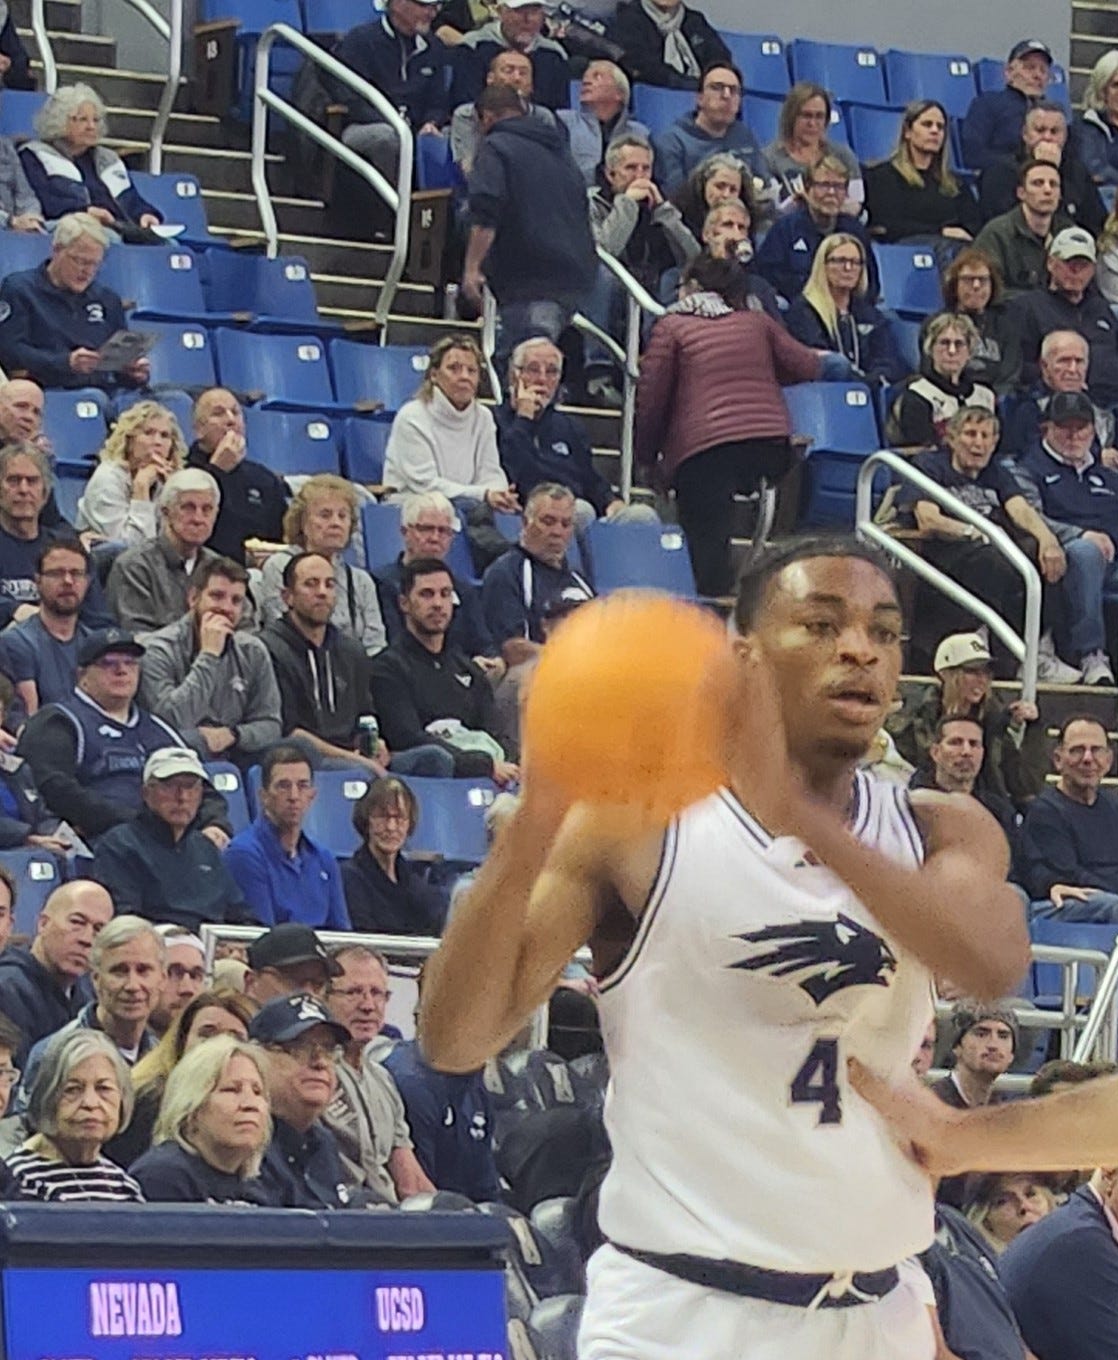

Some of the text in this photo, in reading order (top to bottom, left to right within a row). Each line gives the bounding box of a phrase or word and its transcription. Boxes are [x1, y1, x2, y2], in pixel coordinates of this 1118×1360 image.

[790, 1036, 842, 1124] 4
[91, 1283, 182, 1335] NEVADA
[376, 1287, 424, 1331] UCSD
